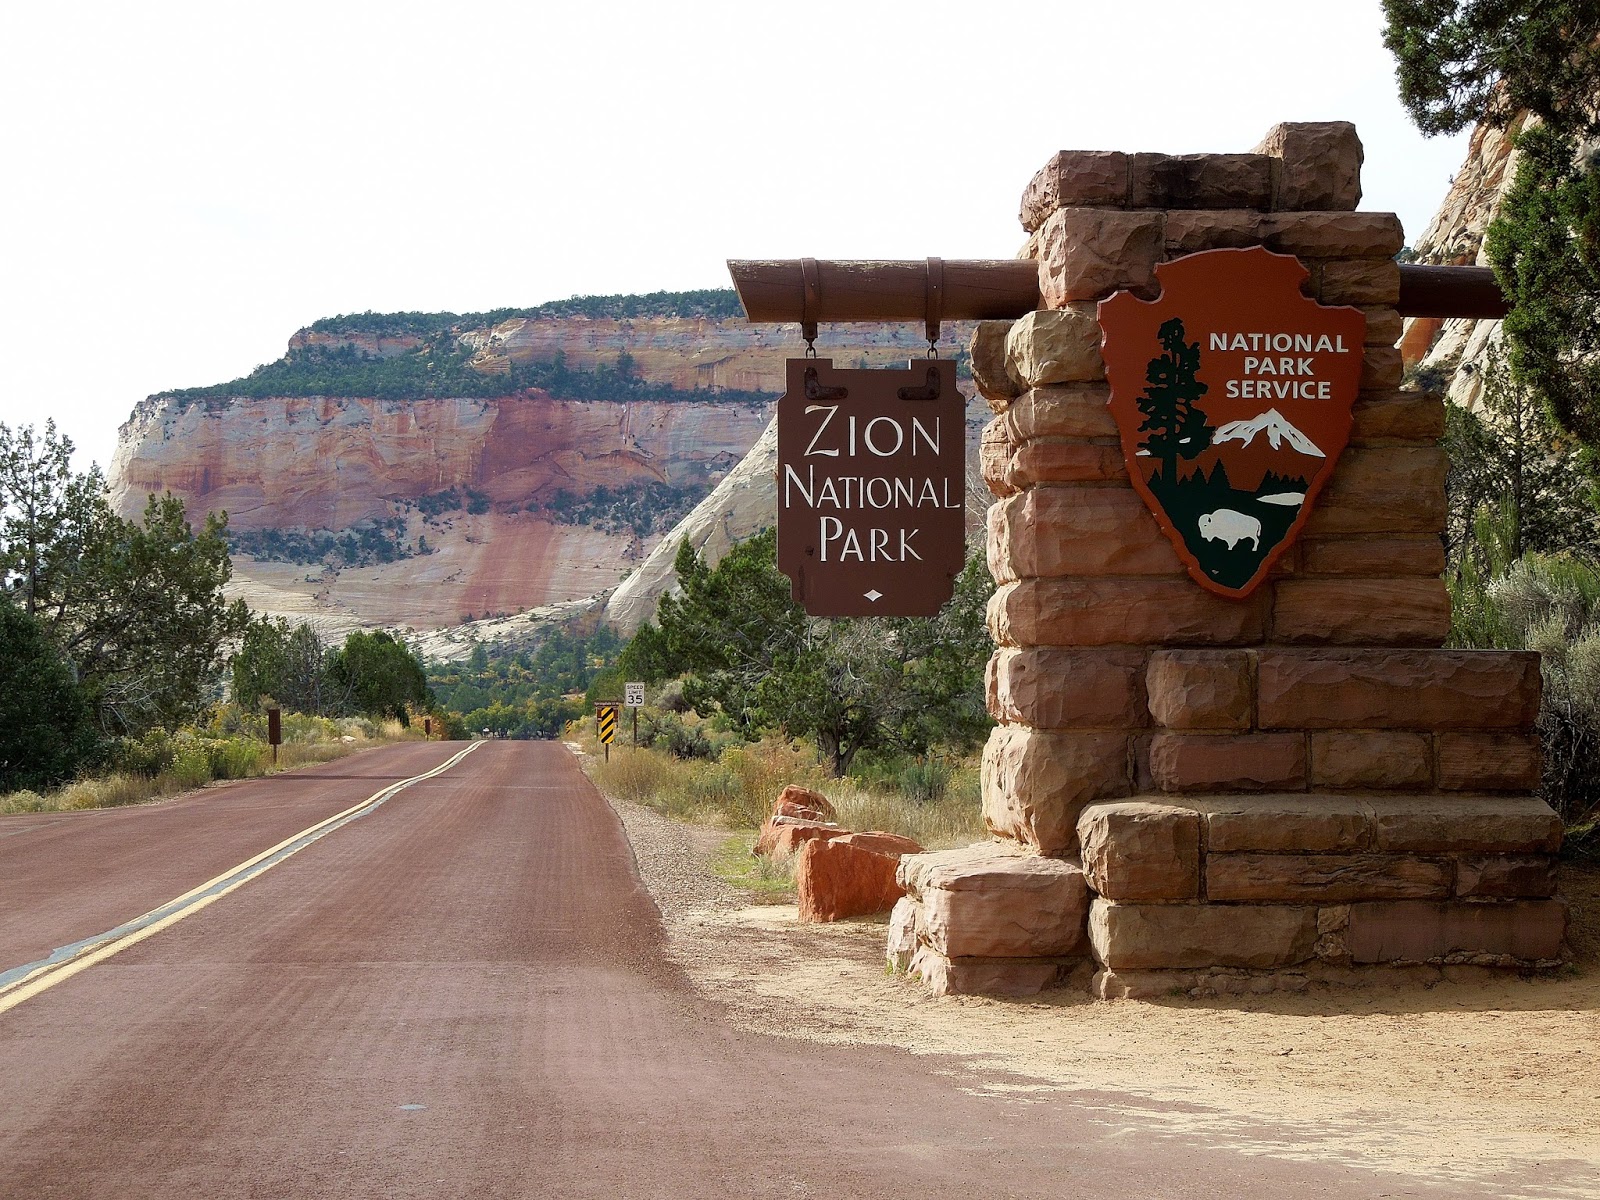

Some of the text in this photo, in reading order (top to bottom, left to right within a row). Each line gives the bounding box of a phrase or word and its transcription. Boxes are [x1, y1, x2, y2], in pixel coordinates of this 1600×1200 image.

[1209, 332, 1349, 353] NATIONAL
[1244, 356, 1315, 376] PARK
[1225, 379, 1331, 400] SERVICE
[803, 404, 941, 457] ZION
[784, 463, 961, 509] NATIONAL
[819, 516, 924, 562] PARK
[628, 695, 643, 704] 35
